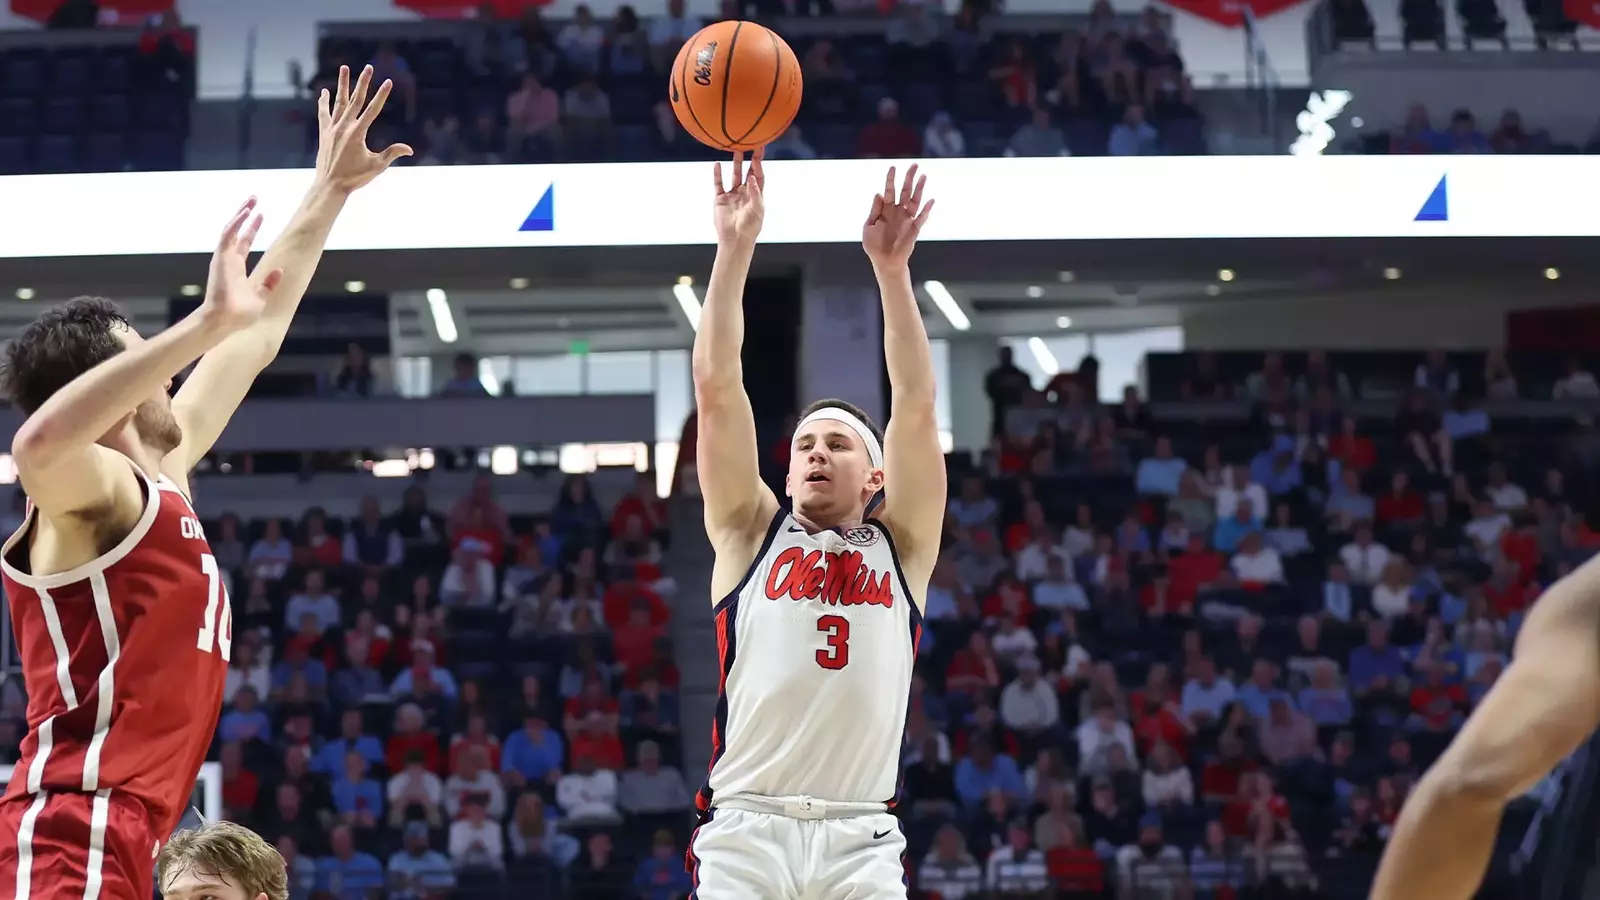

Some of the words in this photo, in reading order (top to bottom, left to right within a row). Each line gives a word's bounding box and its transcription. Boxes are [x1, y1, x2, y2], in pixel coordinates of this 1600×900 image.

[765, 546, 826, 600] Ole
[820, 550, 893, 608] Miss
[816, 615, 849, 669] 3
